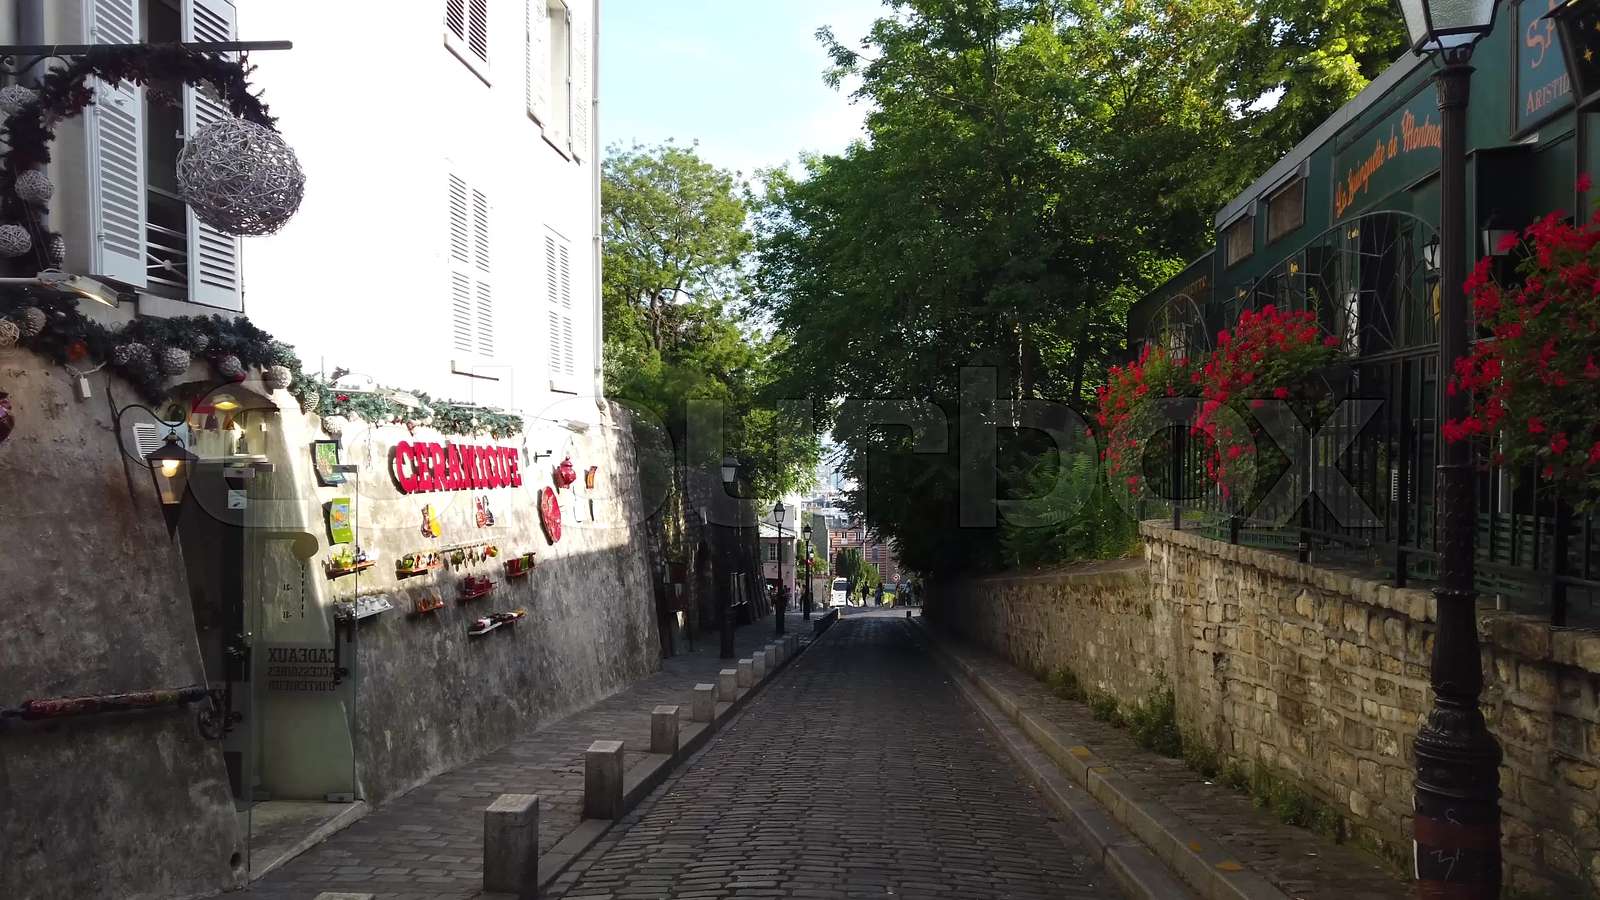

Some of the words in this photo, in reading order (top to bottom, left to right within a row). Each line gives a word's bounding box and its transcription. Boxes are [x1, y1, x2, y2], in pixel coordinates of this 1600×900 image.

[1526, 72, 1571, 117] ARISTID
[1401, 109, 1441, 153] Montma
[395, 440, 523, 493] CERAMIQUE
